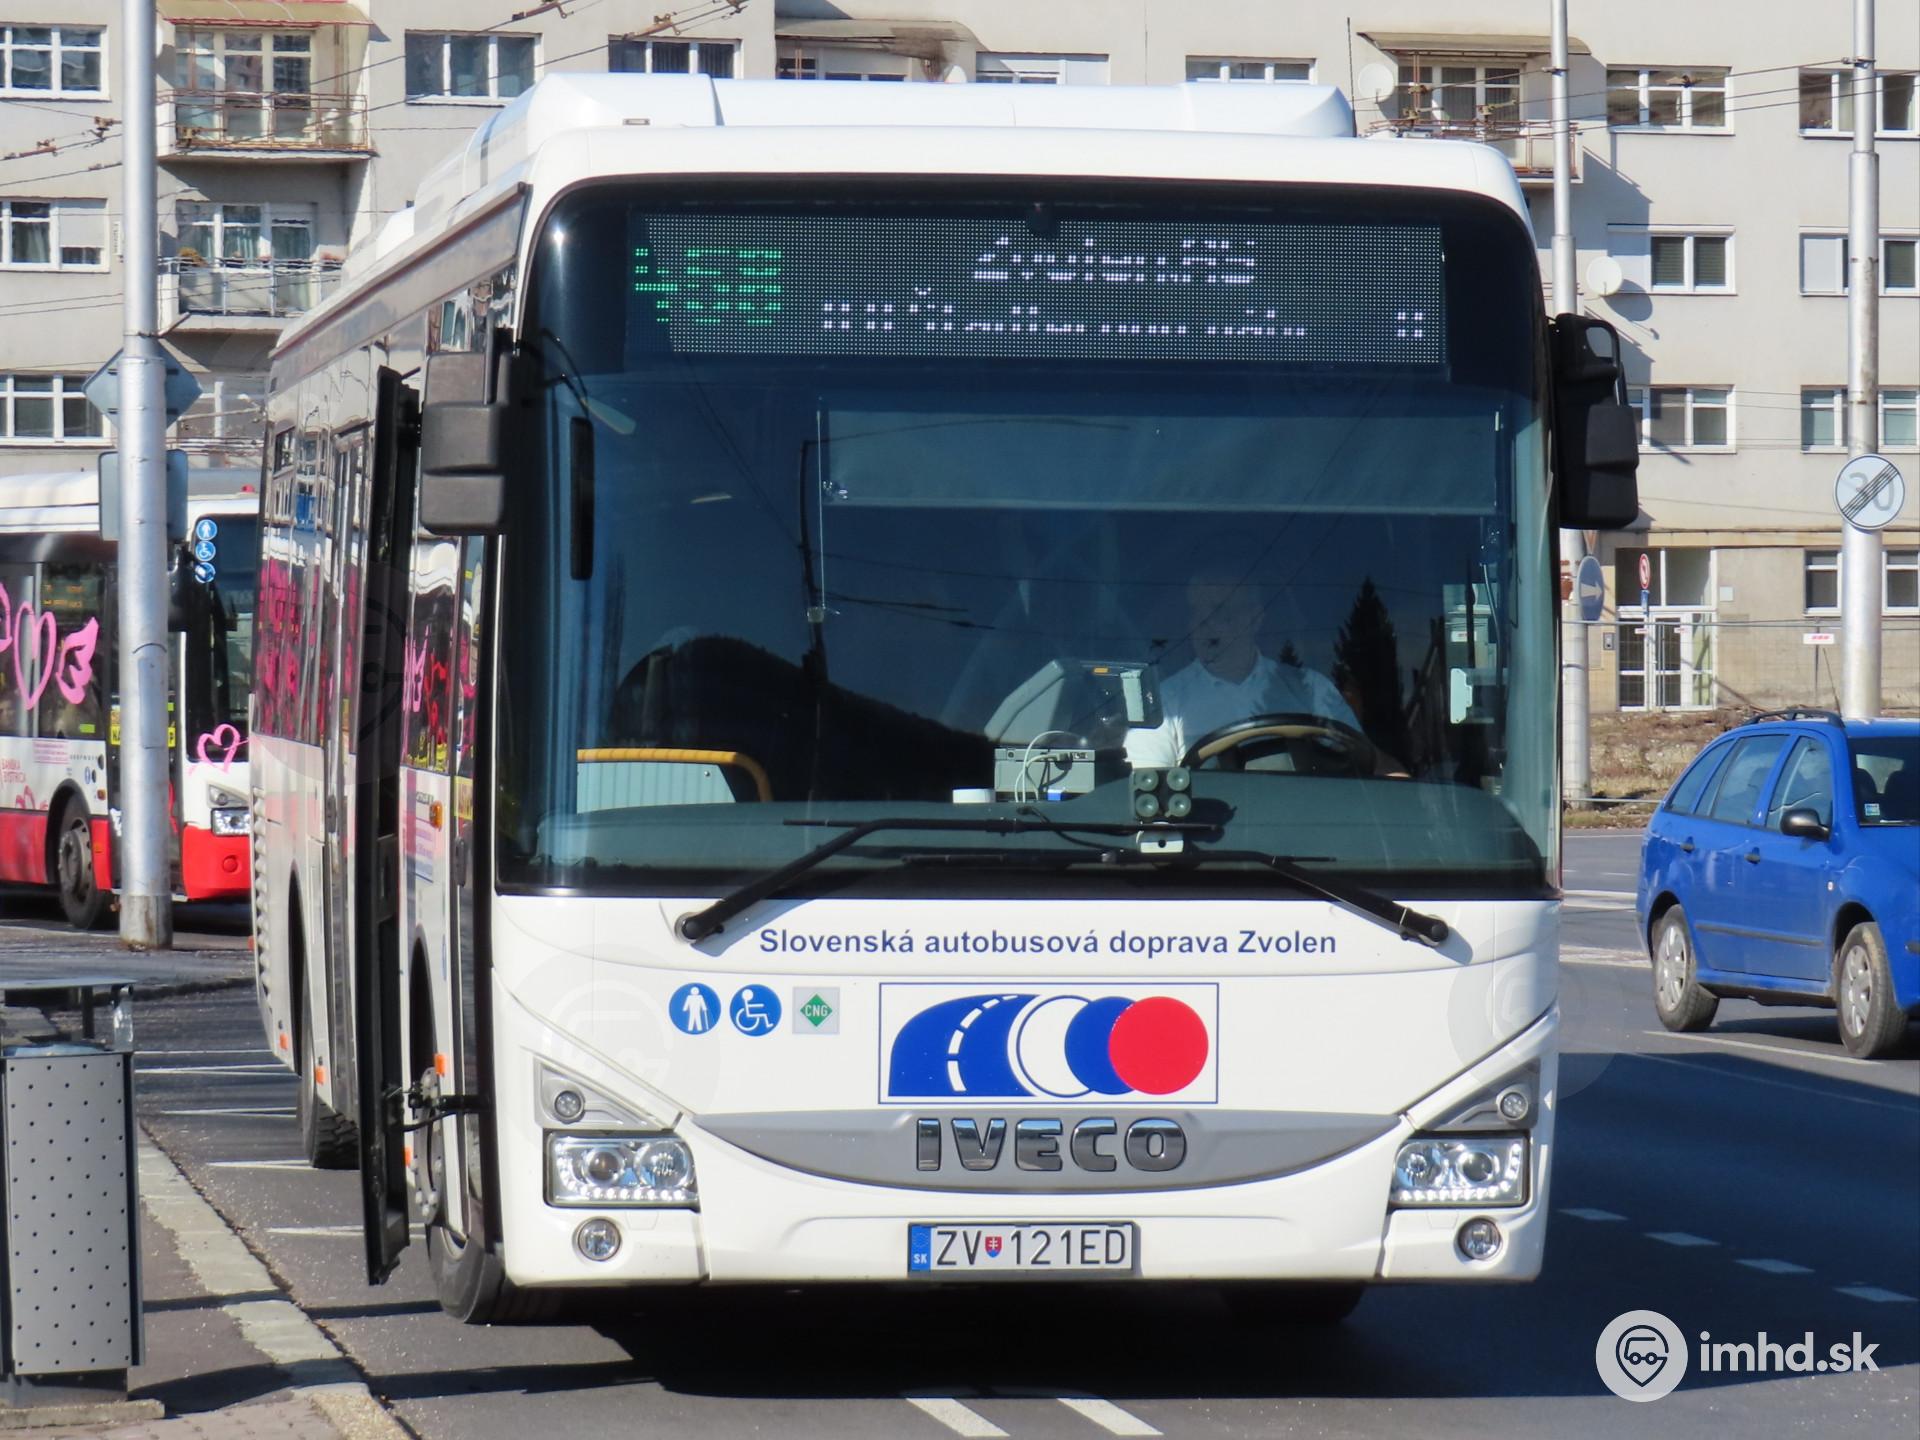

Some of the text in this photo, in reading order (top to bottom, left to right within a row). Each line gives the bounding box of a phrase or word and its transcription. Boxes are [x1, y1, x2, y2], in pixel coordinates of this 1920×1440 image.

[759, 928, 1337, 959] Slovenská autobusová doprava Zvolen
[804, 1004, 829, 1017] CNG
[915, 1117, 1188, 1172] IVECO
[913, 1253, 928, 1265] SK
[937, 1230, 1126, 1265] ZV 121ED
